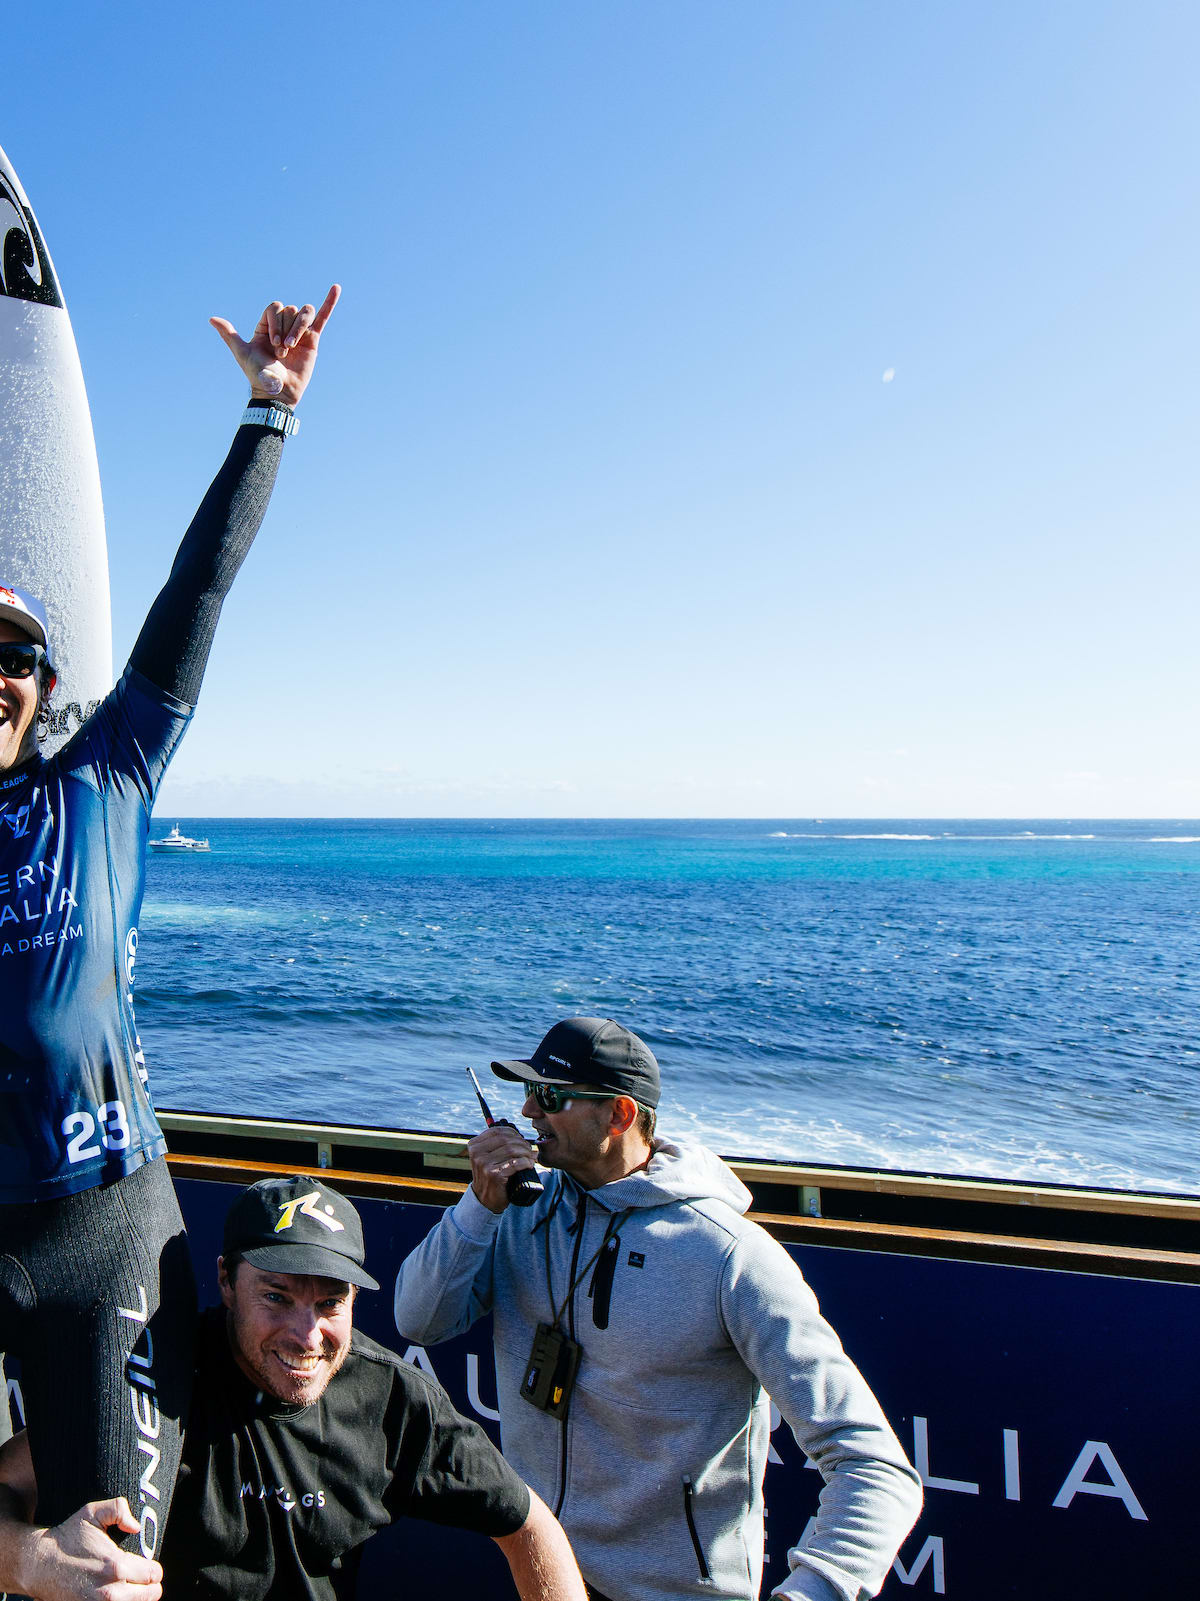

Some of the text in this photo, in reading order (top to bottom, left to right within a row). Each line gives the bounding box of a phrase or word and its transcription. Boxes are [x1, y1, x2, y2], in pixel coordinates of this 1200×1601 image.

[2, 943, 14, 956] A
[19, 924, 84, 952] DREAM
[61, 1101, 131, 1164] 23
[116, 1285, 161, 1560] O'NEILL
